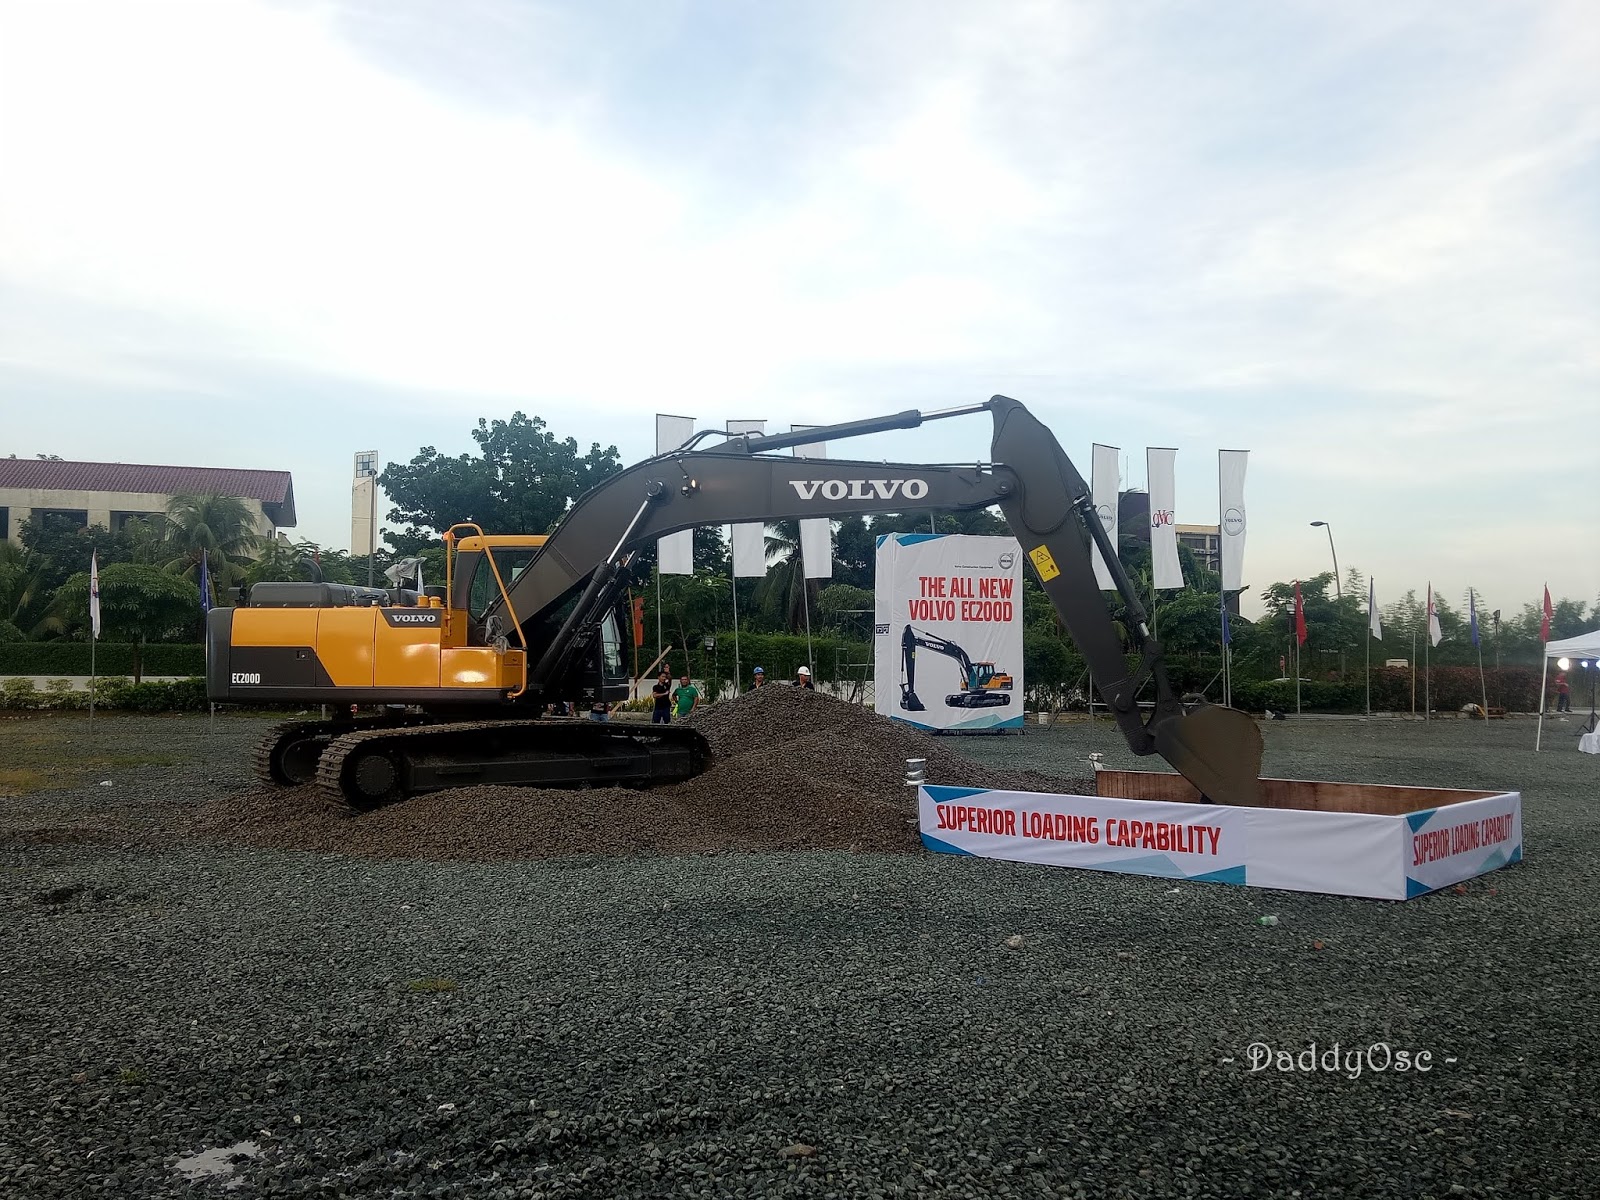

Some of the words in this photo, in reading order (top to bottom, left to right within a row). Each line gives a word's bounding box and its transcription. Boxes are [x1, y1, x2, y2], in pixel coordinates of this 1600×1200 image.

[789, 479, 929, 500] VOLVO
[919, 576, 946, 598] THE
[949, 577, 975, 599] ALL
[979, 578, 1014, 599] NEW
[391, 614, 436, 623] VOLVO
[908, 600, 956, 621] VOLVO
[961, 601, 1013, 622] EC200D
[925, 641, 945, 651] VOLVO
[231, 672, 261, 684] EC200D
[936, 804, 1017, 837] SUPERIOR
[1022, 811, 1100, 845] LOADING
[1105, 818, 1222, 856] CAPABILITY
[1412, 828, 1450, 866] SUPERIOR
[1450, 821, 1479, 856] LOADING
[1481, 812, 1514, 847] CAPABILITY
